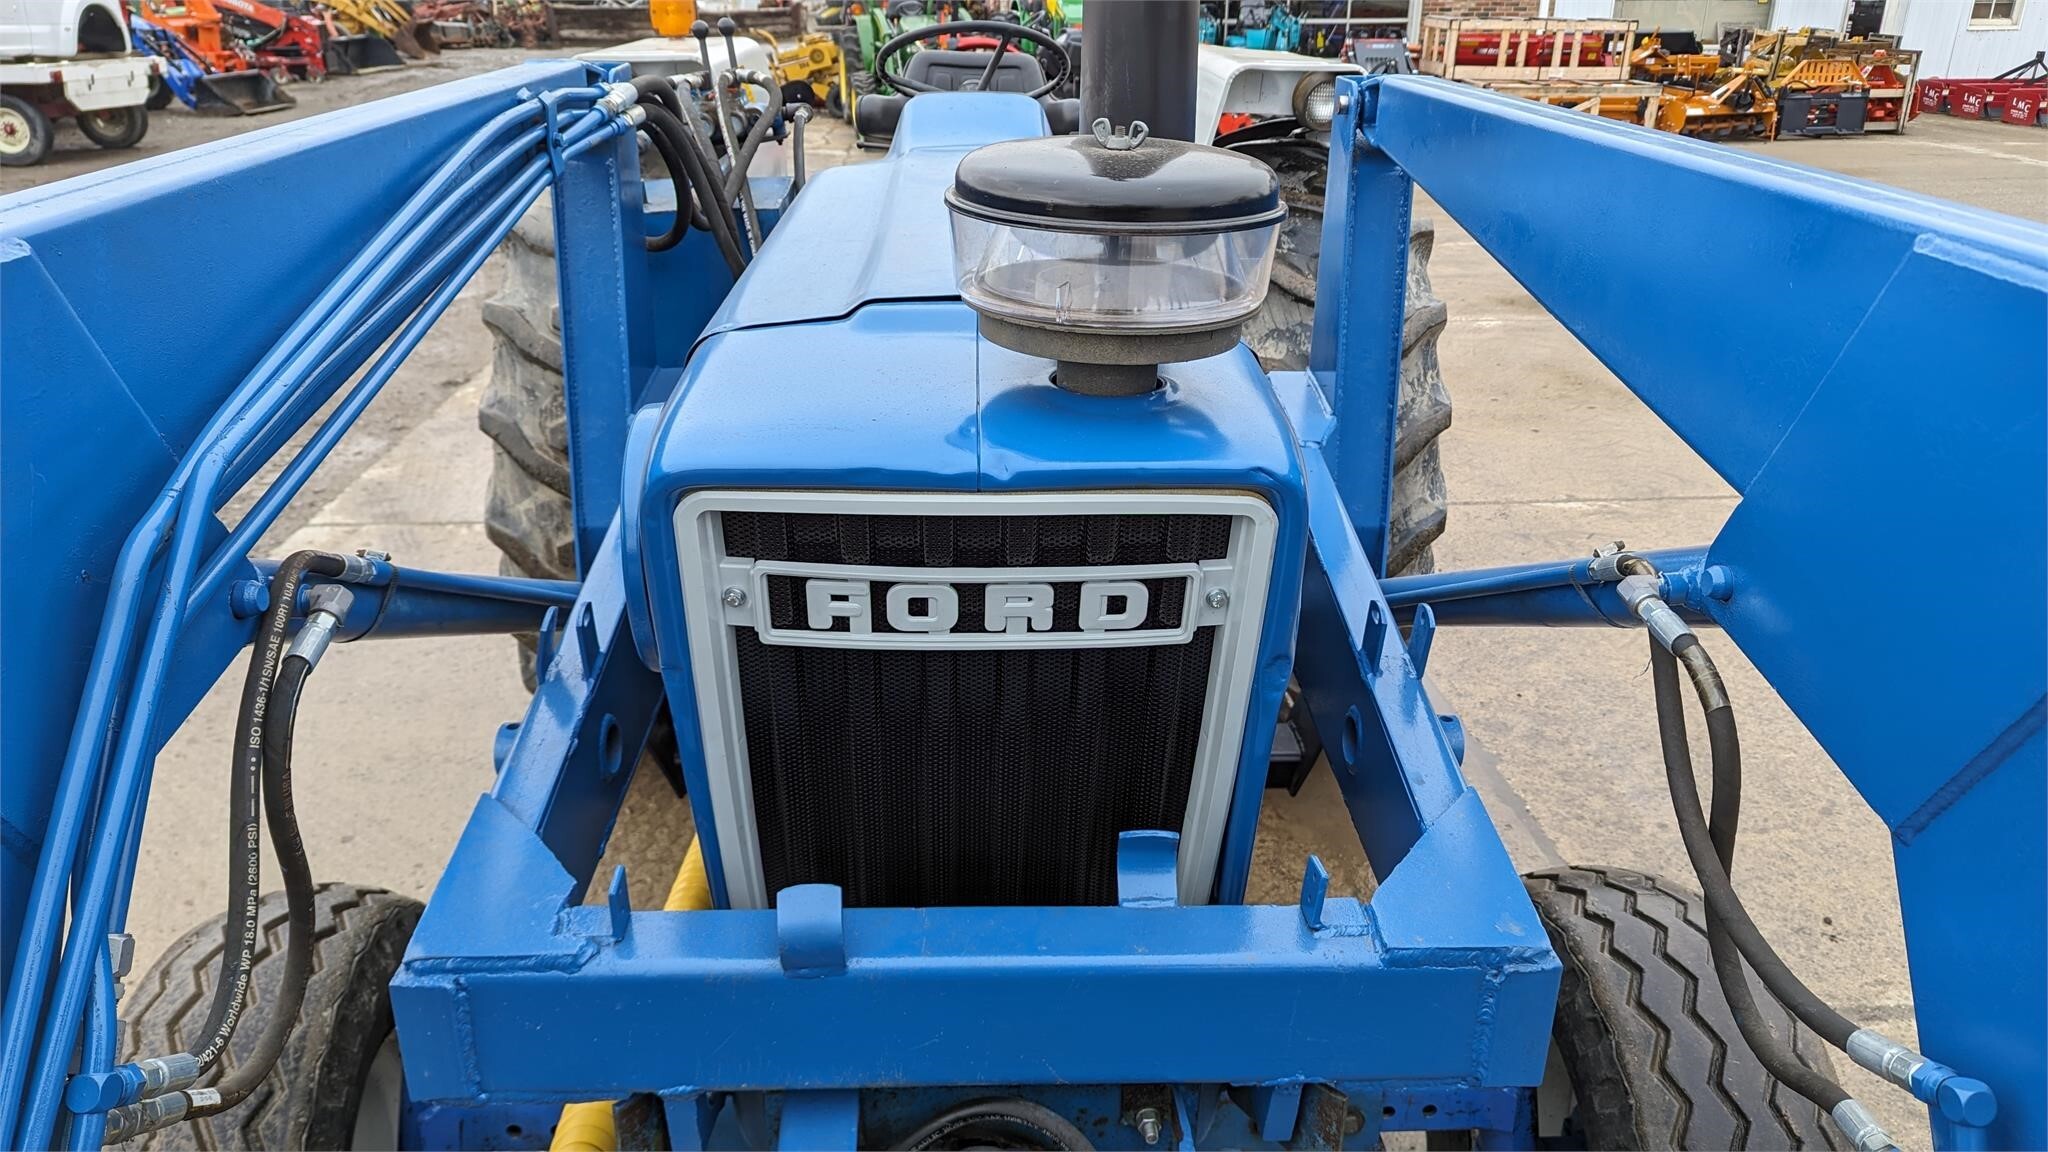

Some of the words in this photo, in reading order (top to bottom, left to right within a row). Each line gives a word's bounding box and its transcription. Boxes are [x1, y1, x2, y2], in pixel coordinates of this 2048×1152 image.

[1924, 85, 1940, 101] LMC
[1963, 92, 1981, 107] LMC
[2012, 97, 2031, 113] LMC
[273, 602, 289, 634] 100R1
[805, 578, 1149, 634] FORD
[253, 635, 281, 723] 1436-1/1SN/SAE
[250, 726, 262, 749] ISO
[247, 822, 259, 849] PSI)
[247, 852, 259, 886] (2600
[246, 889, 258, 917] MPa
[244, 919, 256, 946] 18.0
[240, 950, 252, 971] WP
[219, 973, 248, 1037] Worldwide
